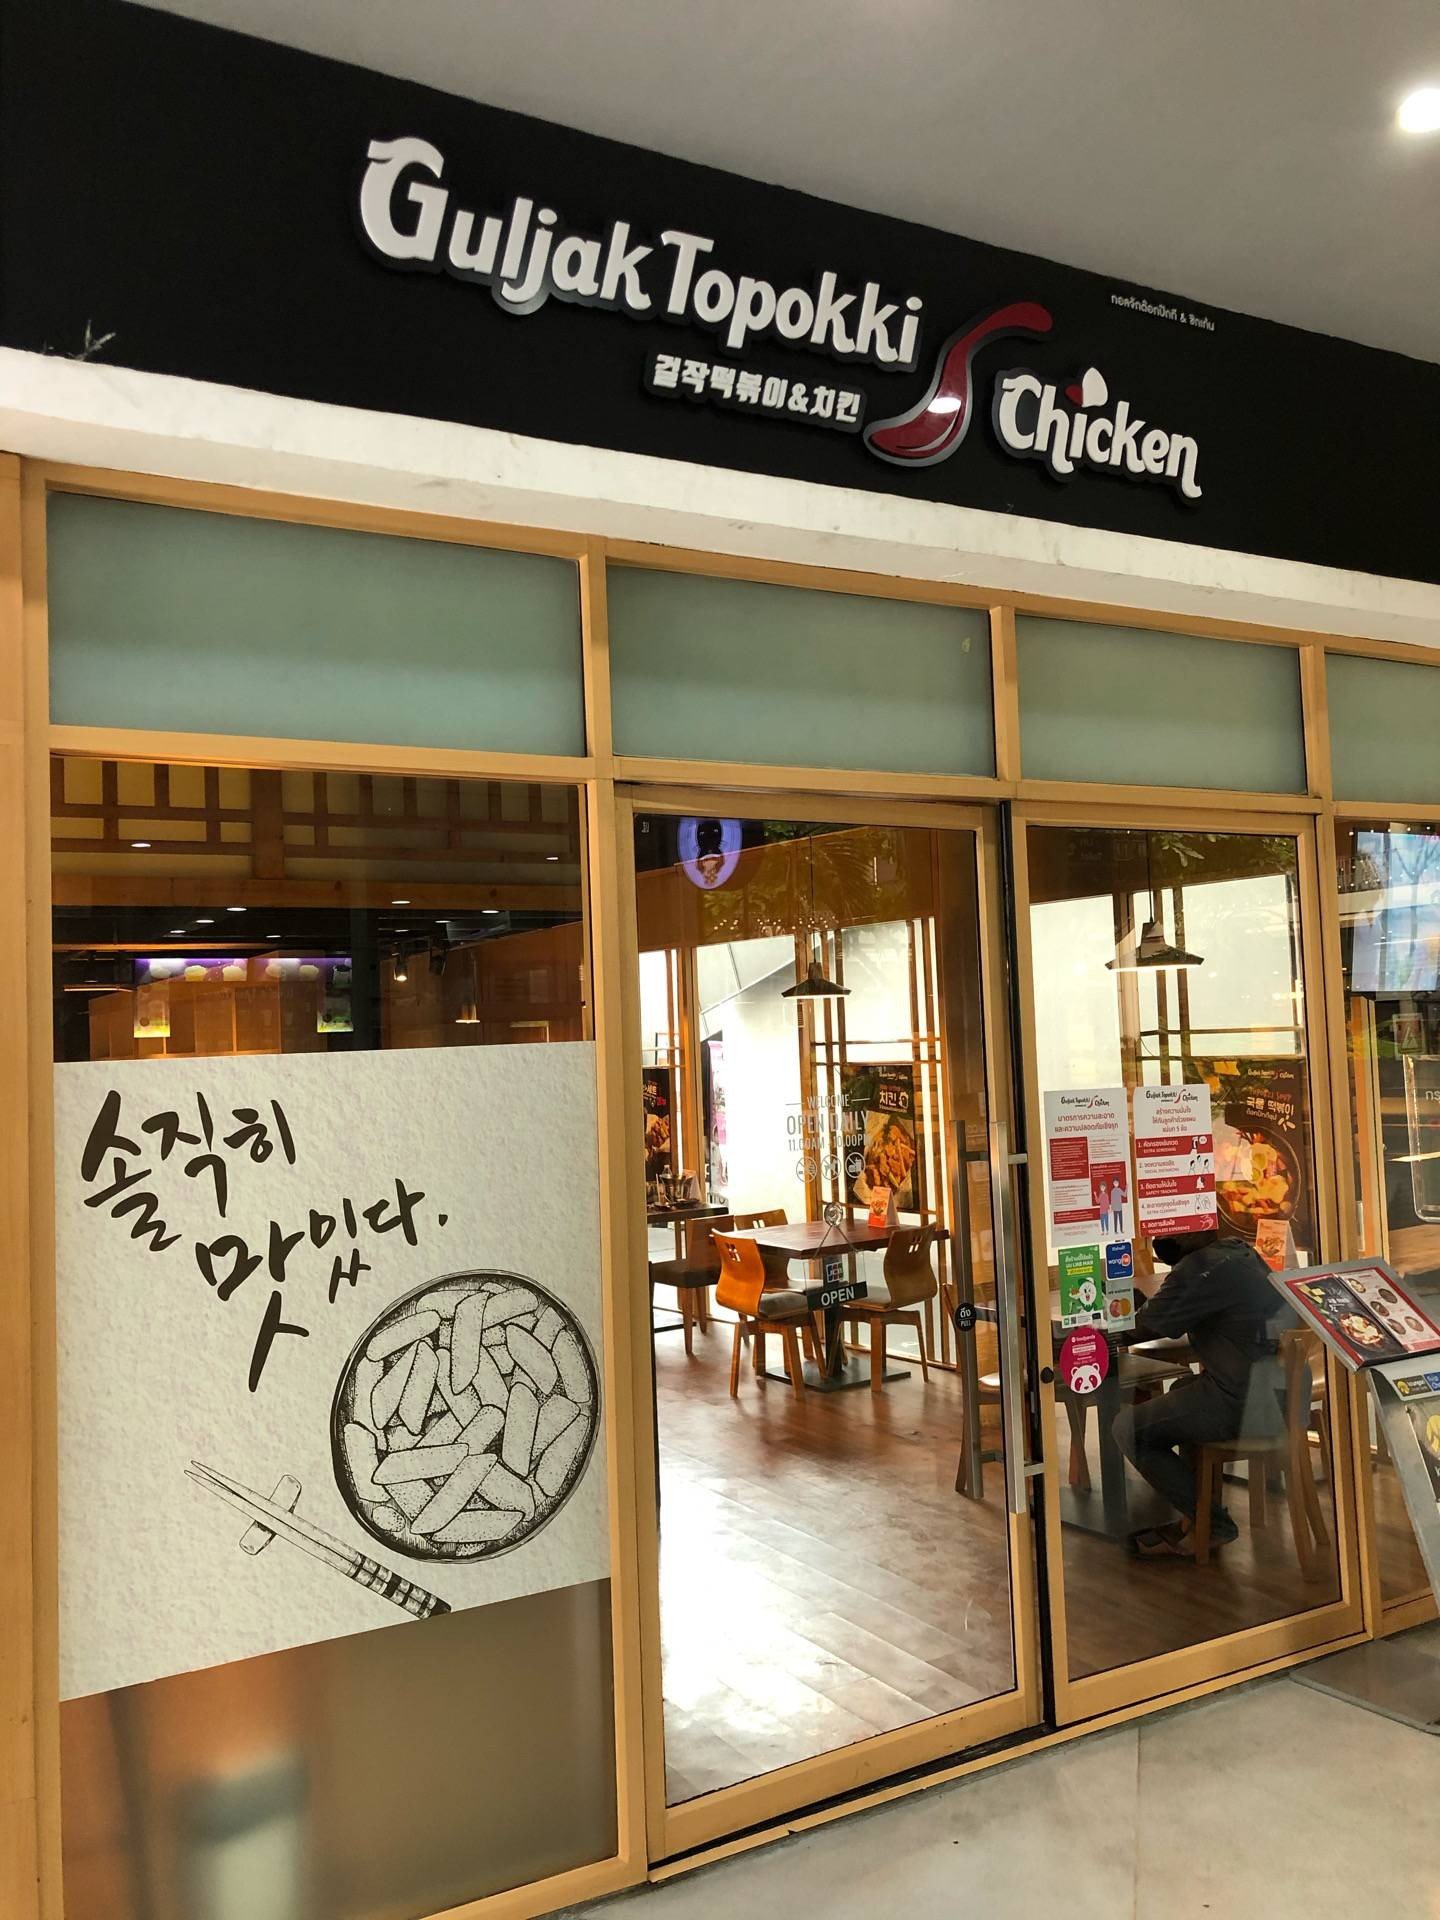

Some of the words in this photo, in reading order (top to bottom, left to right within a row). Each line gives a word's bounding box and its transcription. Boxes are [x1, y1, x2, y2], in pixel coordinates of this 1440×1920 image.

[359, 137, 651, 303] Guljak
[658, 231, 923, 365] Topokki
[652, 353, 861, 424] 걸작떡볶이&치킨
[998, 367, 1204, 499] Chicken
[786, 1113, 825, 1136] OPEN
[829, 1110, 868, 1132] DAILY
[807, 1094, 850, 1109] WELCOME
[879, 1090, 897, 1106] 치킨
[80, 1089, 297, 1252] 솔직히
[194, 1178, 449, 1393] 맛있다.
[821, 1285, 855, 1306] OPEN
